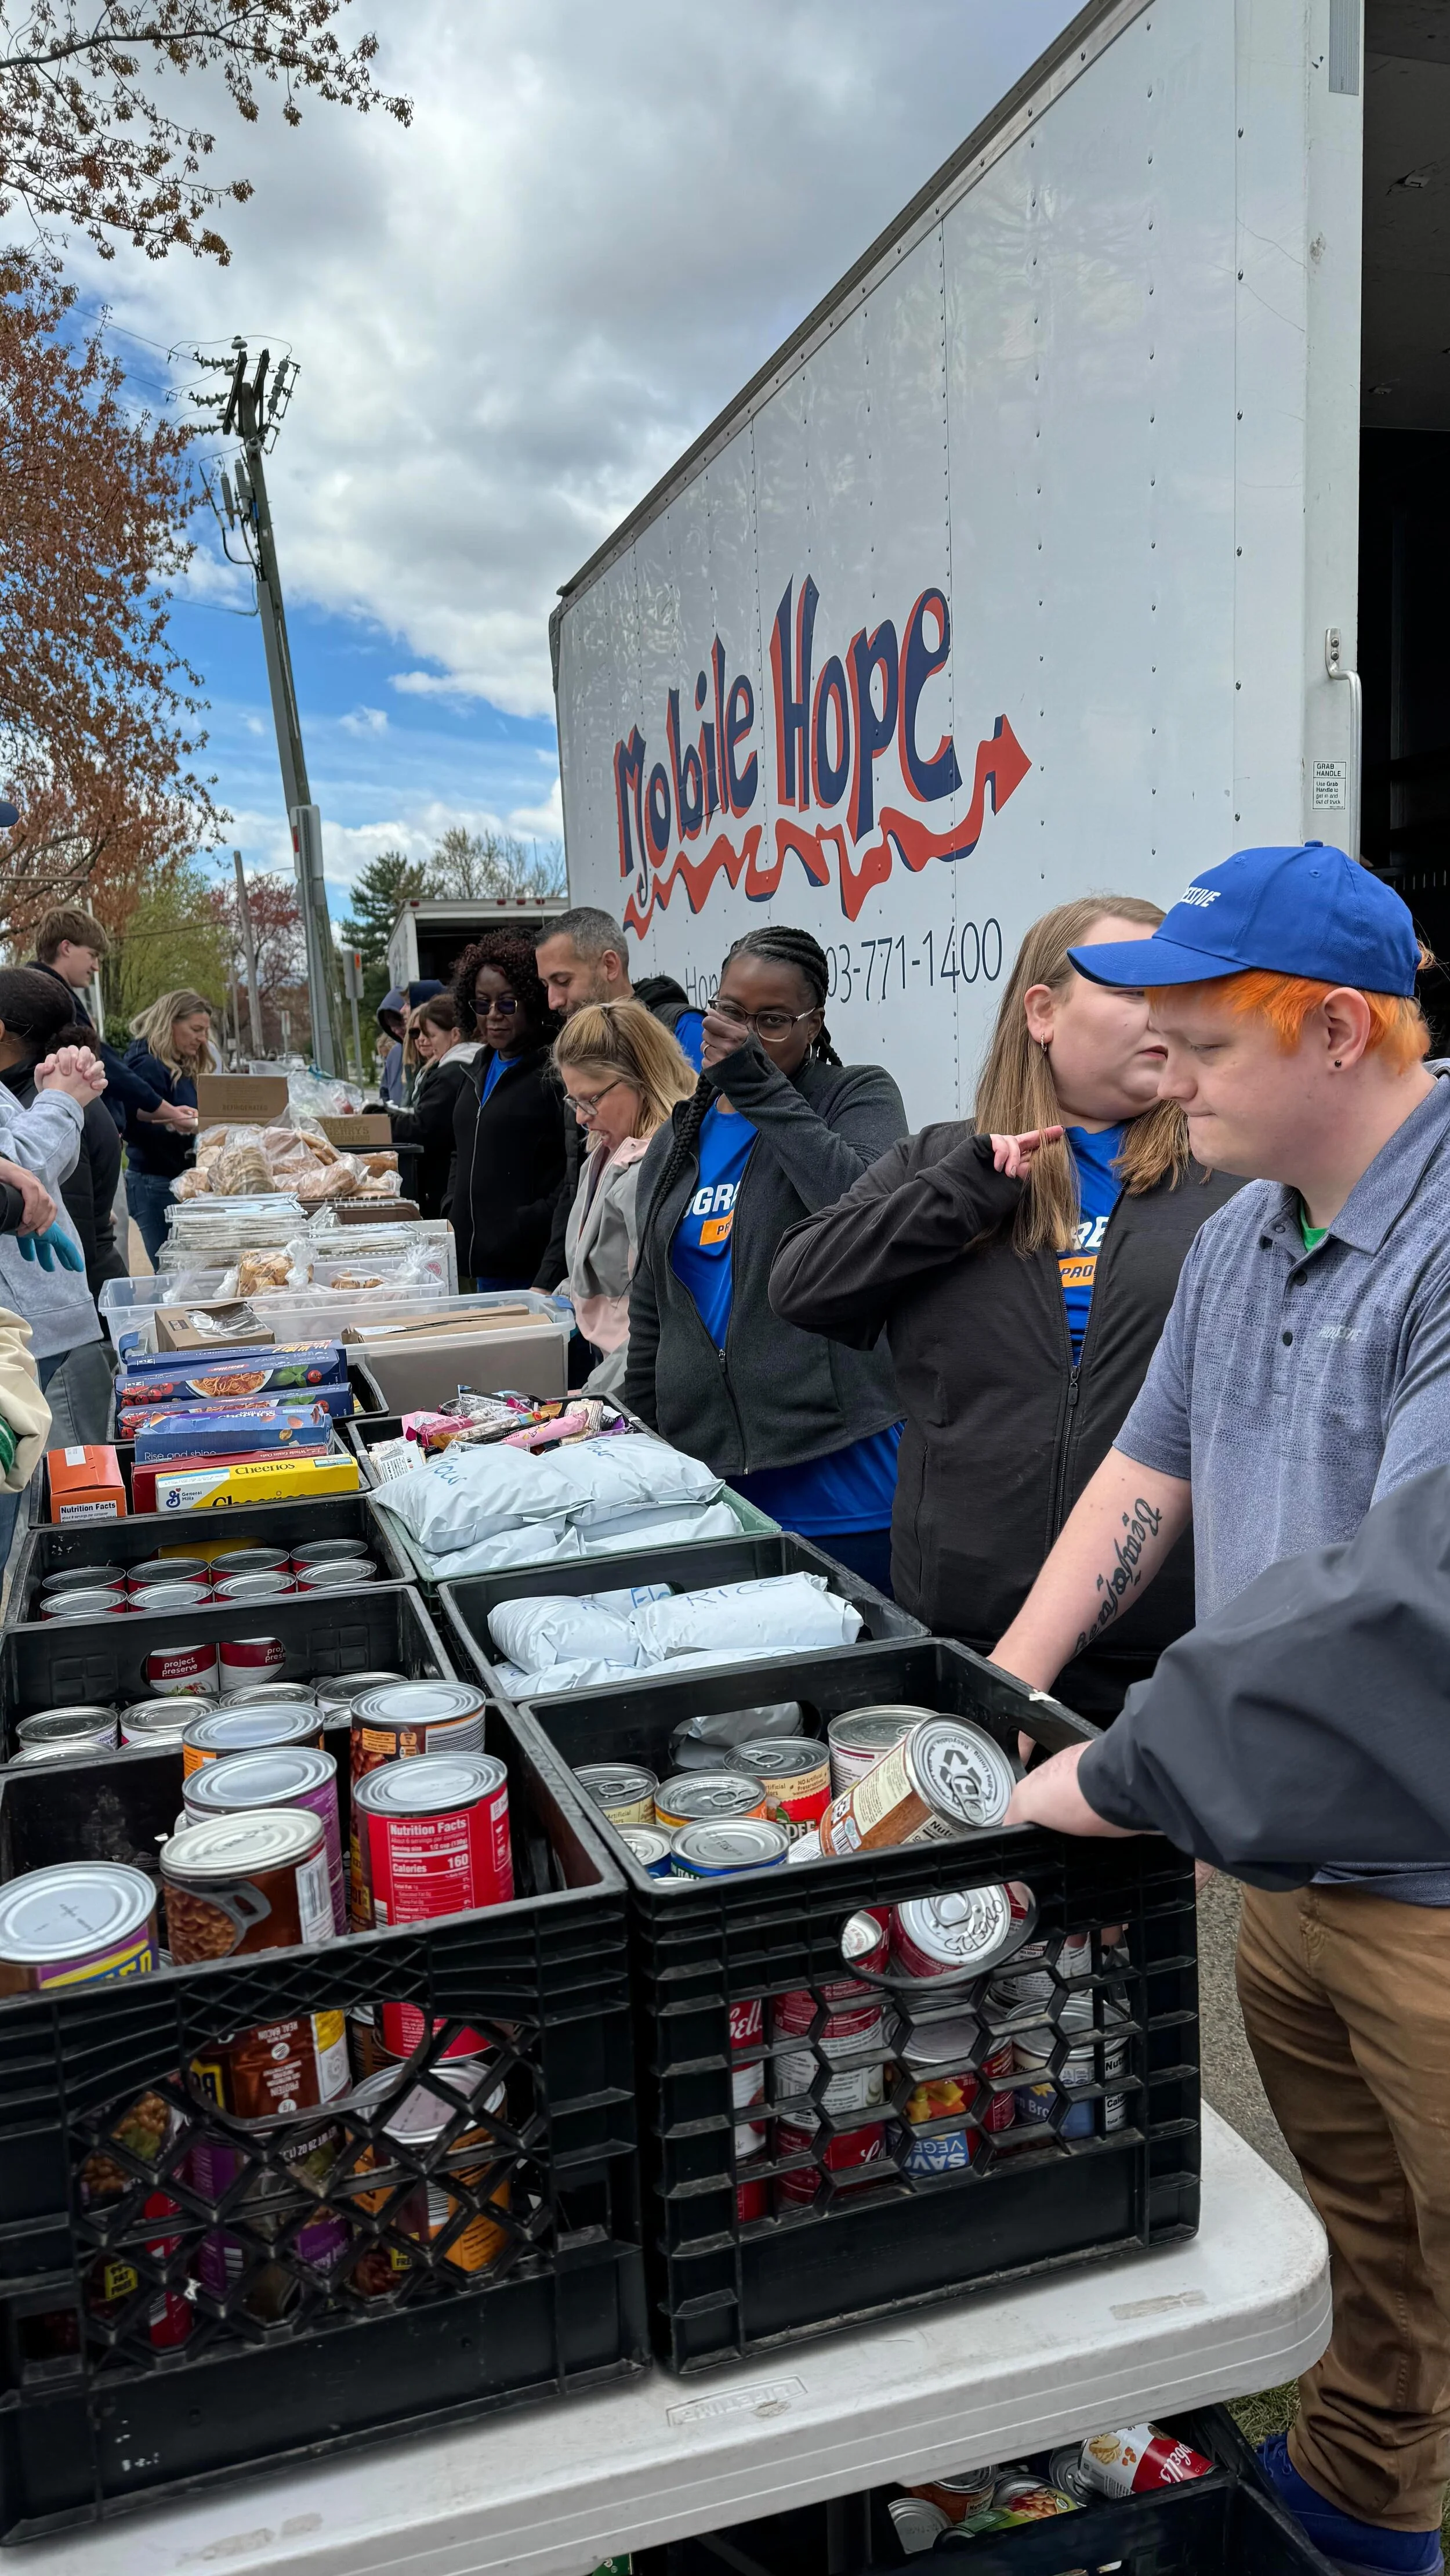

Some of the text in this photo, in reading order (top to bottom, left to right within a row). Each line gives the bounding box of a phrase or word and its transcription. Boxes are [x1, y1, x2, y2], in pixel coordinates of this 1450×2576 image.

[614, 573, 963, 907] Mobile Hope
[144, 1452, 164, 1461] Rise
[167, 1450, 189, 1459] and
[235, 1461, 295, 1475] Cheerios
[61, 1502, 116, 1514] Nutrition Facts
[162, 1663, 198, 1677] preserve
[164, 1656, 195, 1670] project
[390, 1819, 466, 1836] Nutrition Facts
[393, 1853, 469, 1873] Calories 160
[281, 2021, 298, 2033] REAL
